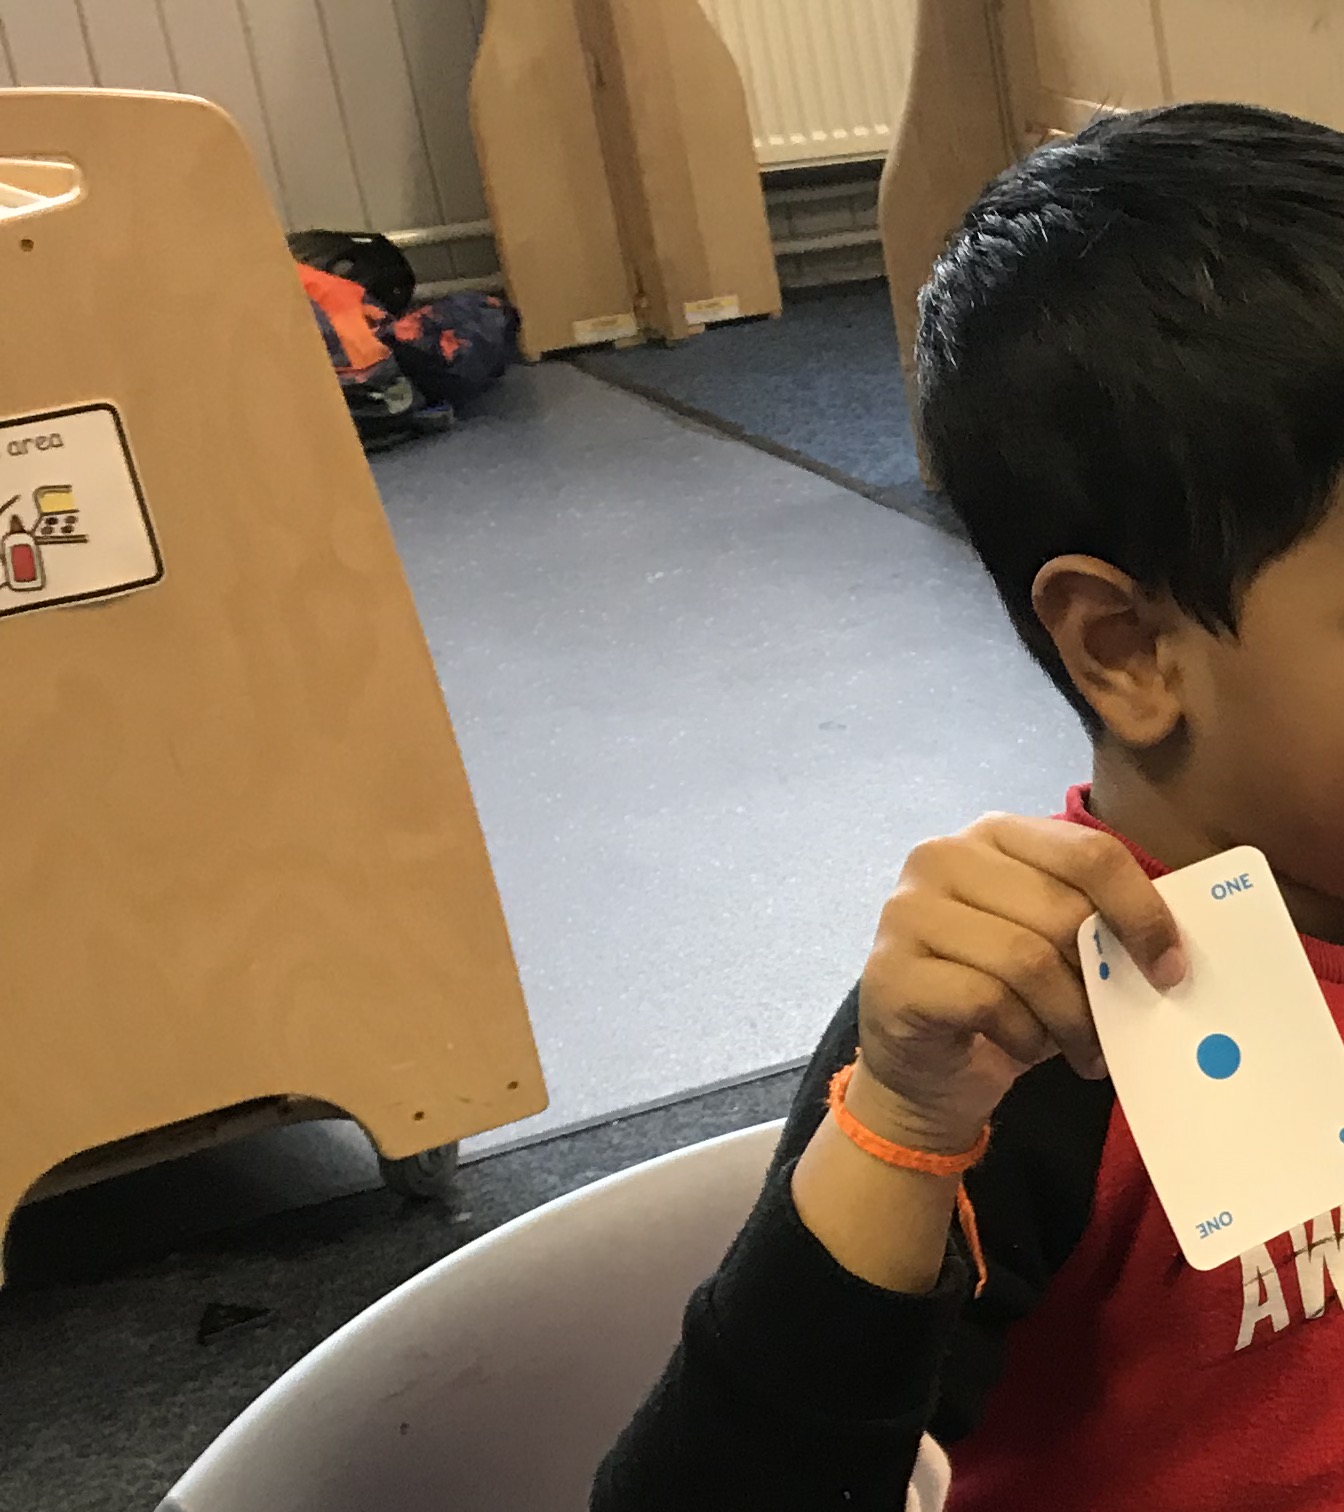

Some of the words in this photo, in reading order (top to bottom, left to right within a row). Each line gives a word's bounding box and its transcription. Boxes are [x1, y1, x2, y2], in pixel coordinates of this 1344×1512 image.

[7, 432, 64, 456] area
[1211, 873, 1254, 900] ONE
[1196, 1210, 1233, 1240] ONE
